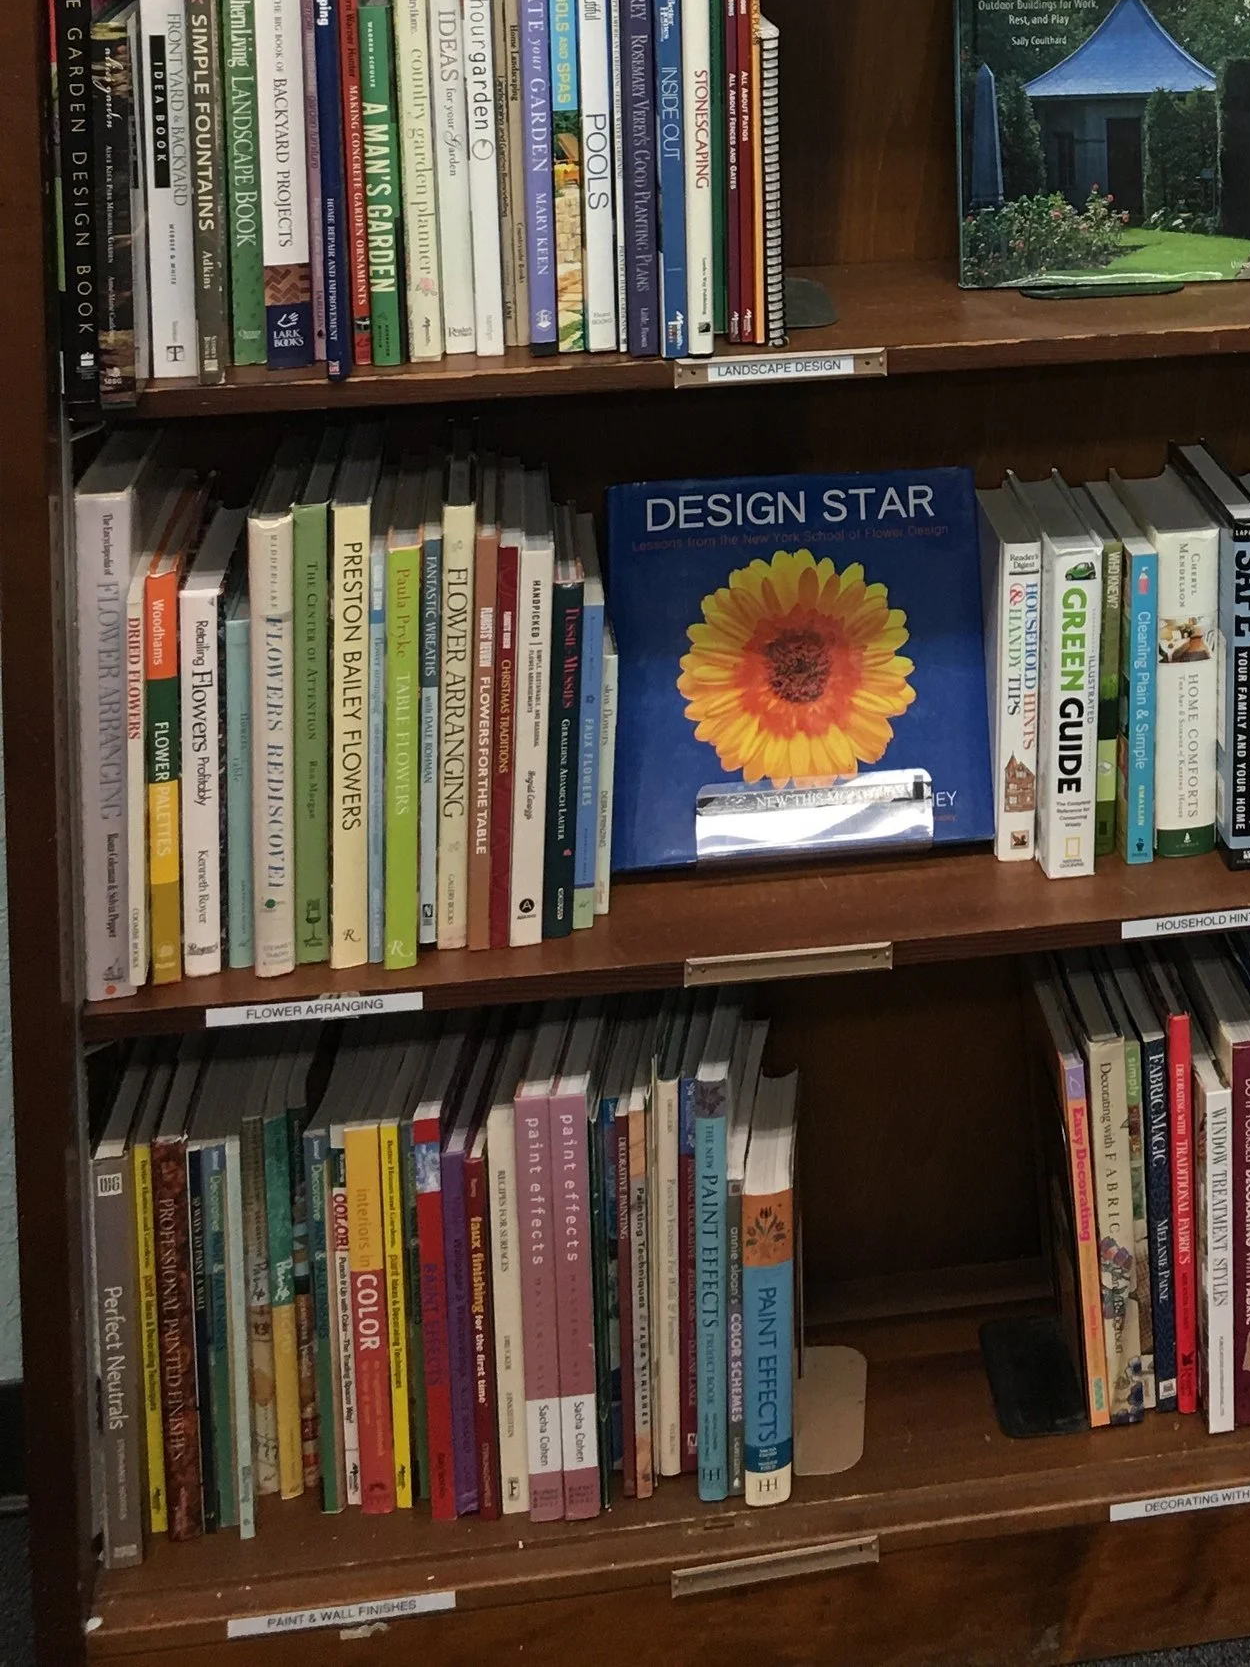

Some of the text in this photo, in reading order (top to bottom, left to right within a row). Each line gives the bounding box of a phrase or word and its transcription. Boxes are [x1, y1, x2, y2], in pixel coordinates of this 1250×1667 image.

[978, 0, 1099, 11] Outdoor Buildings for Work,
[1009, 14, 1069, 26] Rest, and Play
[1011, 35, 1067, 47] Sally Coulthard
[68, 28, 86, 132] GARDEN
[191, 14, 214, 232] SIMPLE FOUNTAINS
[694, 69, 710, 190] STONESCAPING
[72, 151, 90, 247] DESIGN
[362, 102, 396, 294] A MAN'S GARDEN
[585, 114, 609, 211] POOLS
[76, 265, 93, 335] BOOK
[718, 360, 841, 377] LANDSCAPE DESIGN
[646, 485, 935, 532] DESIGN STAR
[341, 541, 364, 831] PRESTON BAILEY FLOWERS
[444, 566, 468, 819] FLOWER ARRANGING
[1058, 587, 1087, 794] GREEN GUIDE
[1156, 915, 1226, 931] HOUSEHOLD
[246, 998, 384, 1019] FLOWER ARRANGING
[356, 1274, 381, 1351] COLOR
[758, 1287, 777, 1442] PAINT EFFECTS
[1144, 1493, 1219, 1513] DECORATING
[1221, 1490, 1250, 1501] WITH
[268, 1599, 417, 1628] PAINT & WALL FINISHES
